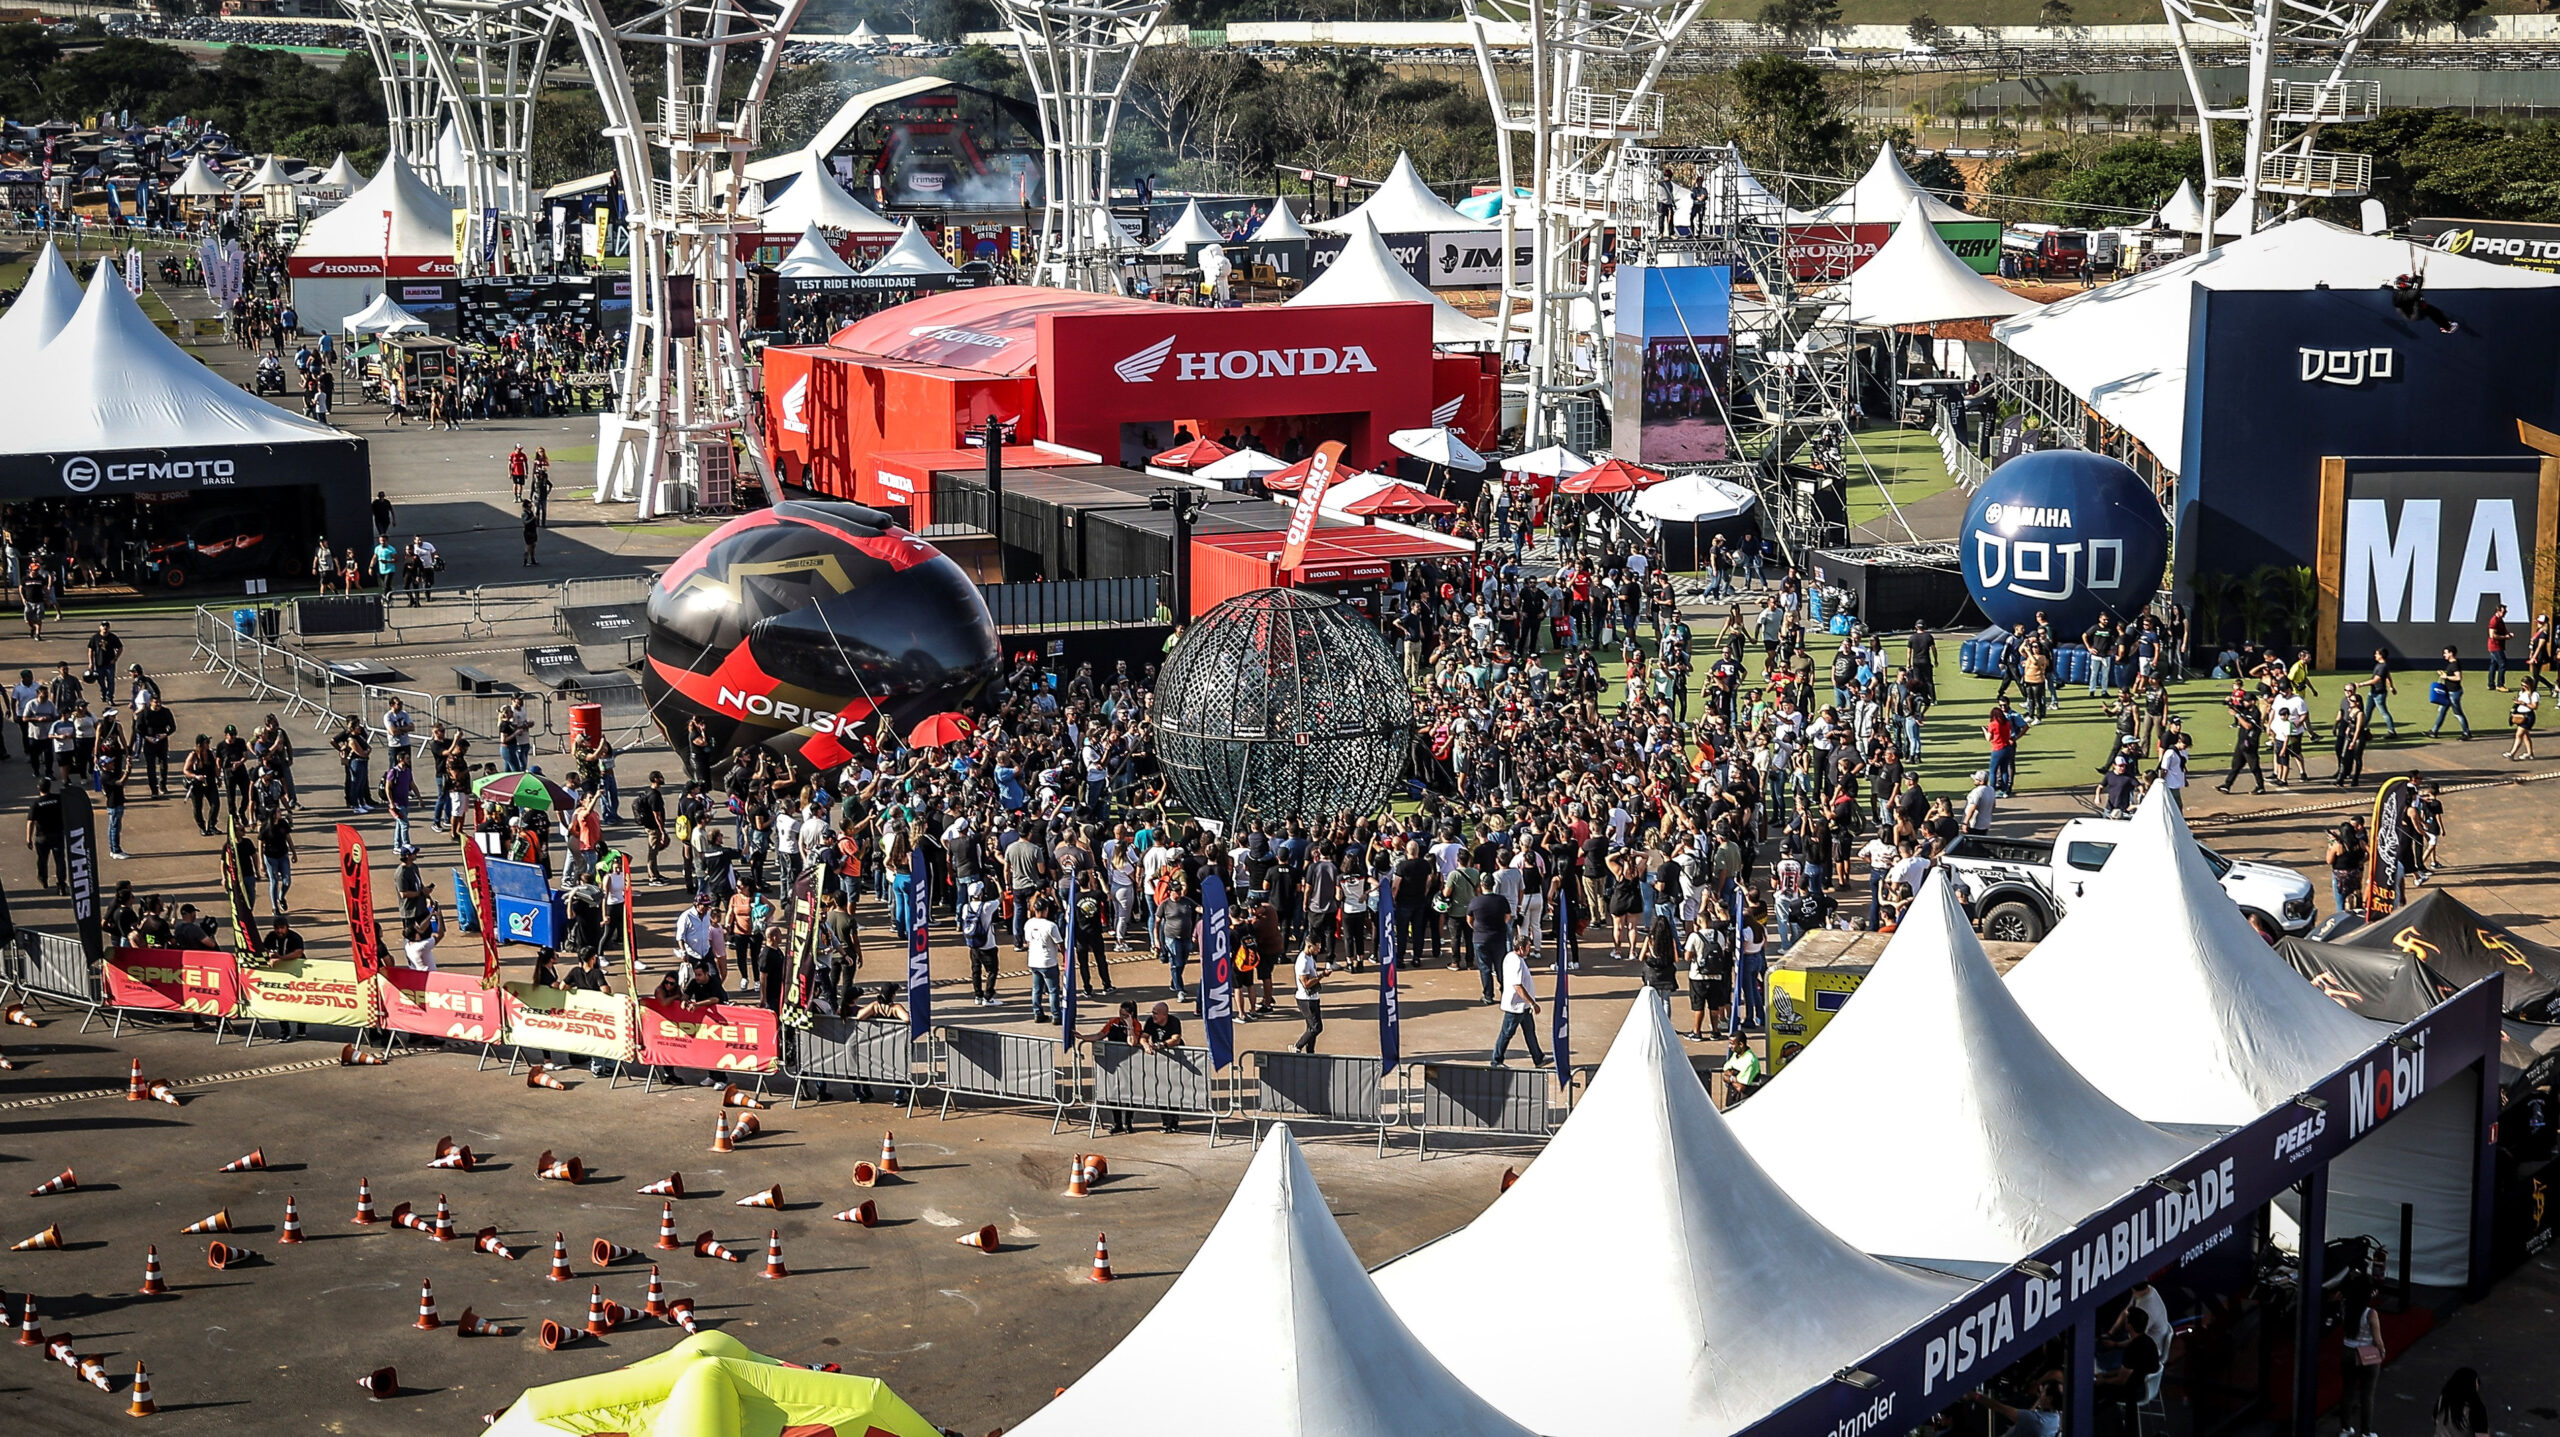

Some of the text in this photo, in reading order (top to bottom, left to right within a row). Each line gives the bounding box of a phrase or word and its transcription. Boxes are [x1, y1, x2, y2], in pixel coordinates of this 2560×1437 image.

[1787, 243, 1878, 259] HONDA
[2471, 237, 2525, 256] PRO
[325, 264, 382, 273] HONDA
[795, 277, 917, 290] TEST RIDE MOBILIDADE
[930, 329, 1015, 348] HONDA
[1176, 345, 1377, 381] HONDA
[2299, 347, 2393, 386] DOJO
[107, 459, 235, 481] CFMOTO
[202, 477, 236, 485] BRASIL
[2003, 505, 2073, 529] YAMAHA
[1353, 567, 1385, 575] HONDA
[1974, 529, 2123, 601] DOJO
[2343, 499, 2530, 623] MA
[536, 655, 574, 664] FESTIVAL
[717, 686, 866, 741] NORISK
[70, 827, 91, 920] SUHAI
[910, 879, 929, 990] Mobil
[127, 965, 199, 986] SPIKE
[1207, 909, 1230, 1020] Mobil
[189, 986, 221, 996] PEELS
[257, 981, 356, 995] PEELS ACELERE
[262, 992, 358, 1010] COM ESTILO
[400, 989, 466, 1011] SPIKE
[454, 1012, 485, 1022] PEELS
[520, 1006, 616, 1026] PEELS ACELERE
[525, 1017, 617, 1041] COM ESTILO
[660, 1020, 738, 1043] SPIKE
[725, 1042, 759, 1051] PEELS
[2348, 1030, 2425, 1141] Mobil
[2274, 1110, 2327, 1161] PEELS
[2185, 1244, 2204, 1265] PODE
[2205, 1235, 2218, 1251] SER
[2219, 1224, 2233, 1243] SUA
[1923, 1157, 2235, 1397] PISTA DE HABILIDADE
